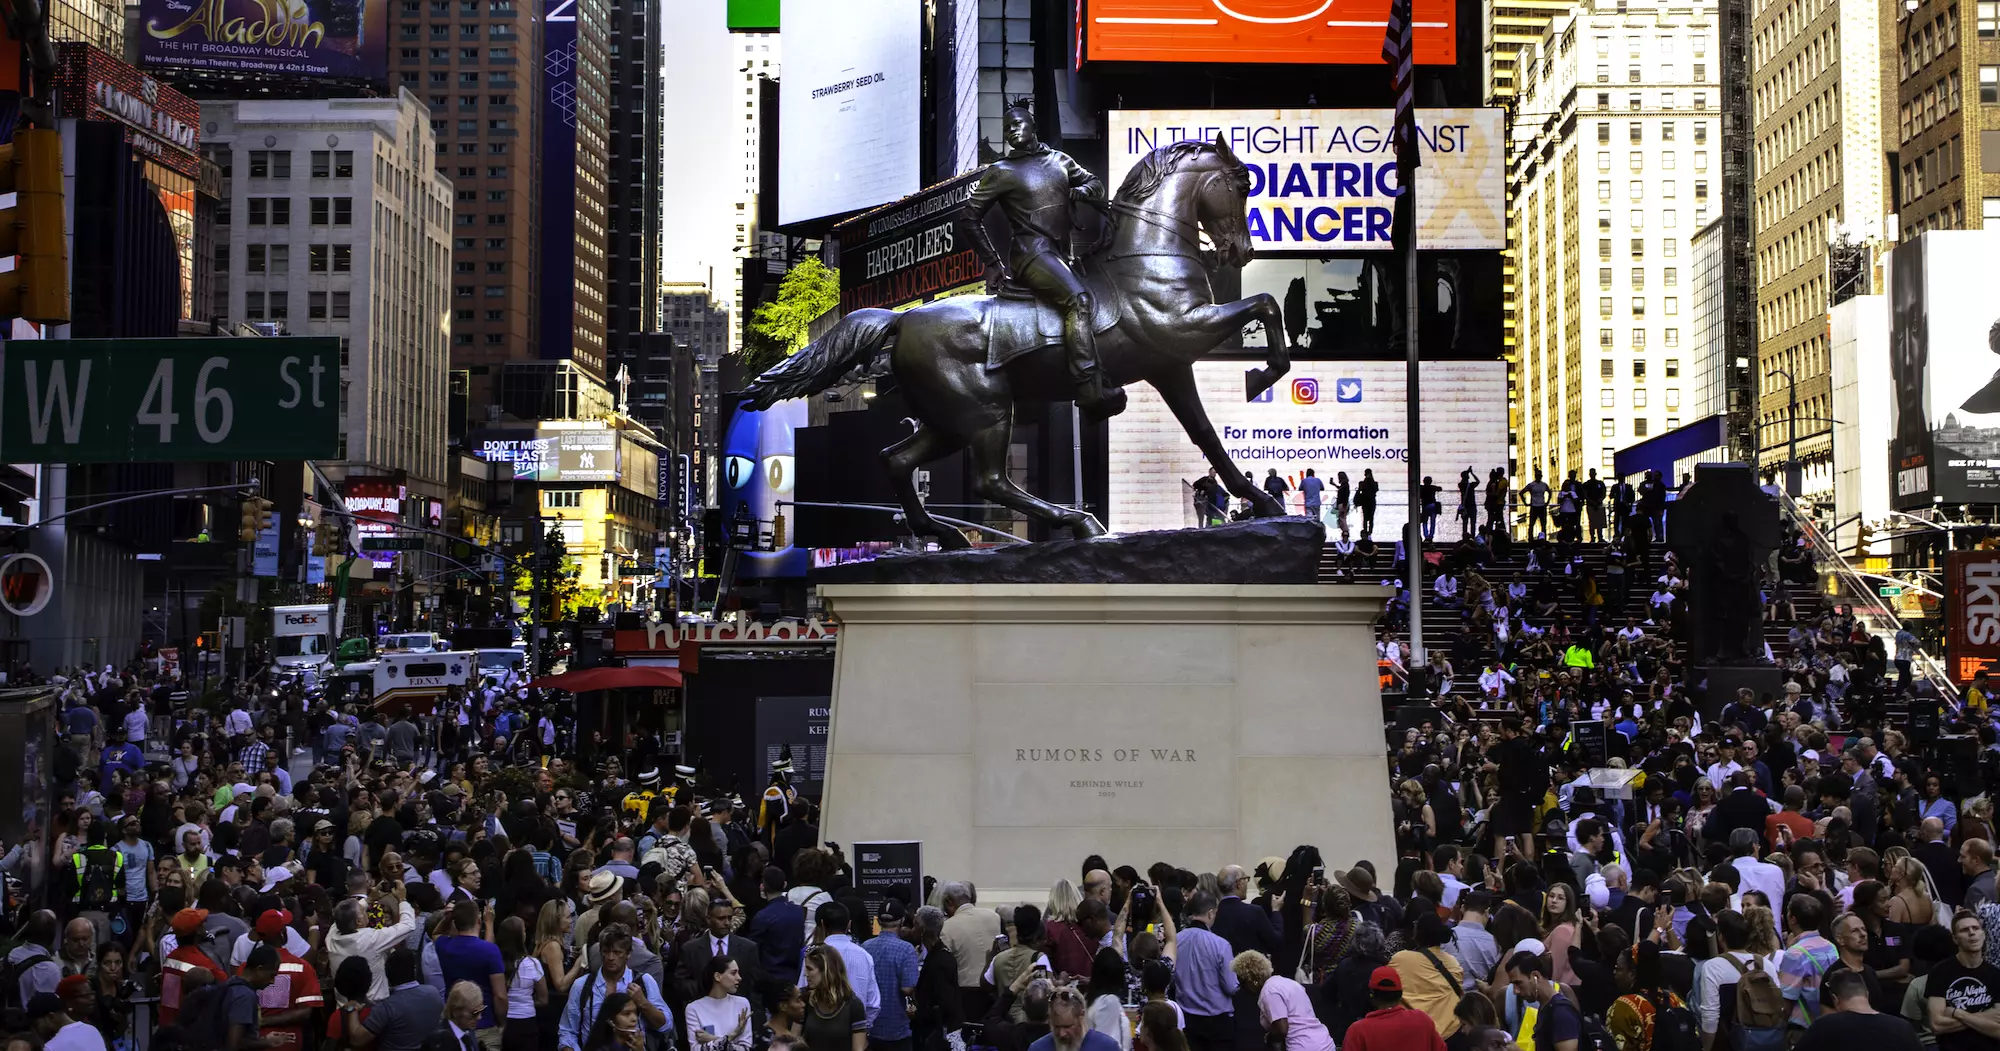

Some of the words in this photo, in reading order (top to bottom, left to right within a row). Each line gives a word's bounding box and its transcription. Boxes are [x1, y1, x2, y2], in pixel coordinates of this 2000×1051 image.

[165, 0, 192, 13] Disney
[147, 0, 325, 49] Aladdin
[159, 41, 179, 50] THE
[182, 43, 199, 52] HIT
[202, 44, 262, 55] BROADWAY
[264, 48, 310, 59] MUSICAL
[145, 54, 162, 63] New
[209, 59, 239, 69] Theatre,
[240, 61, 277, 71] Broadway
[278, 63, 284, 71] &
[286, 64, 305, 72] 42nd
[306, 65, 329, 73] Street
[811, 80, 855, 99] STRAWBERRY
[855, 75, 873, 88] SEED
[874, 72, 885, 82] OIL
[1128, 127, 1157, 154] IN
[1231, 126, 1319, 154] FIGHT
[1327, 125, 1470, 153] AGANST
[867, 221, 877, 237] AN
[918, 190, 955, 217] AMERICAN
[866, 236, 915, 279] HARPER
[916, 221, 953, 263] LEE'S
[24, 359, 92, 445] W
[136, 356, 234, 444] 46
[278, 354, 326, 409] St
[1224, 426, 1248, 440] For
[1252, 428, 1293, 440] more
[1298, 426, 1389, 440] information
[484, 440, 519, 450] DON'T
[521, 440, 549, 450] MISS
[484, 450, 511, 462] THE
[514, 450, 549, 462] LAST
[513, 461, 549, 471] STAND
[658, 454, 667, 501] NOVOTEL
[678, 463, 686, 522] BROADWAY
[345, 497, 400, 514] BROADWAY.COM
[1965, 559, 2000, 646] tkts
[285, 614, 318, 625] FedEx
[646, 610, 827, 650] nuchas
[409, 677, 443, 686] F.D.N.Y.
[653, 697, 676, 705] BEER
[1015, 749, 1103, 762] RUMORS
[1113, 749, 1140, 762] OF
[1150, 749, 1197, 762] WAR
[1070, 780, 1112, 788] KEHINDE
[1114, 780, 1144, 788] WILEY
[1963, 985, 1987, 997] Night
[1951, 993, 1992, 1010] Radio
